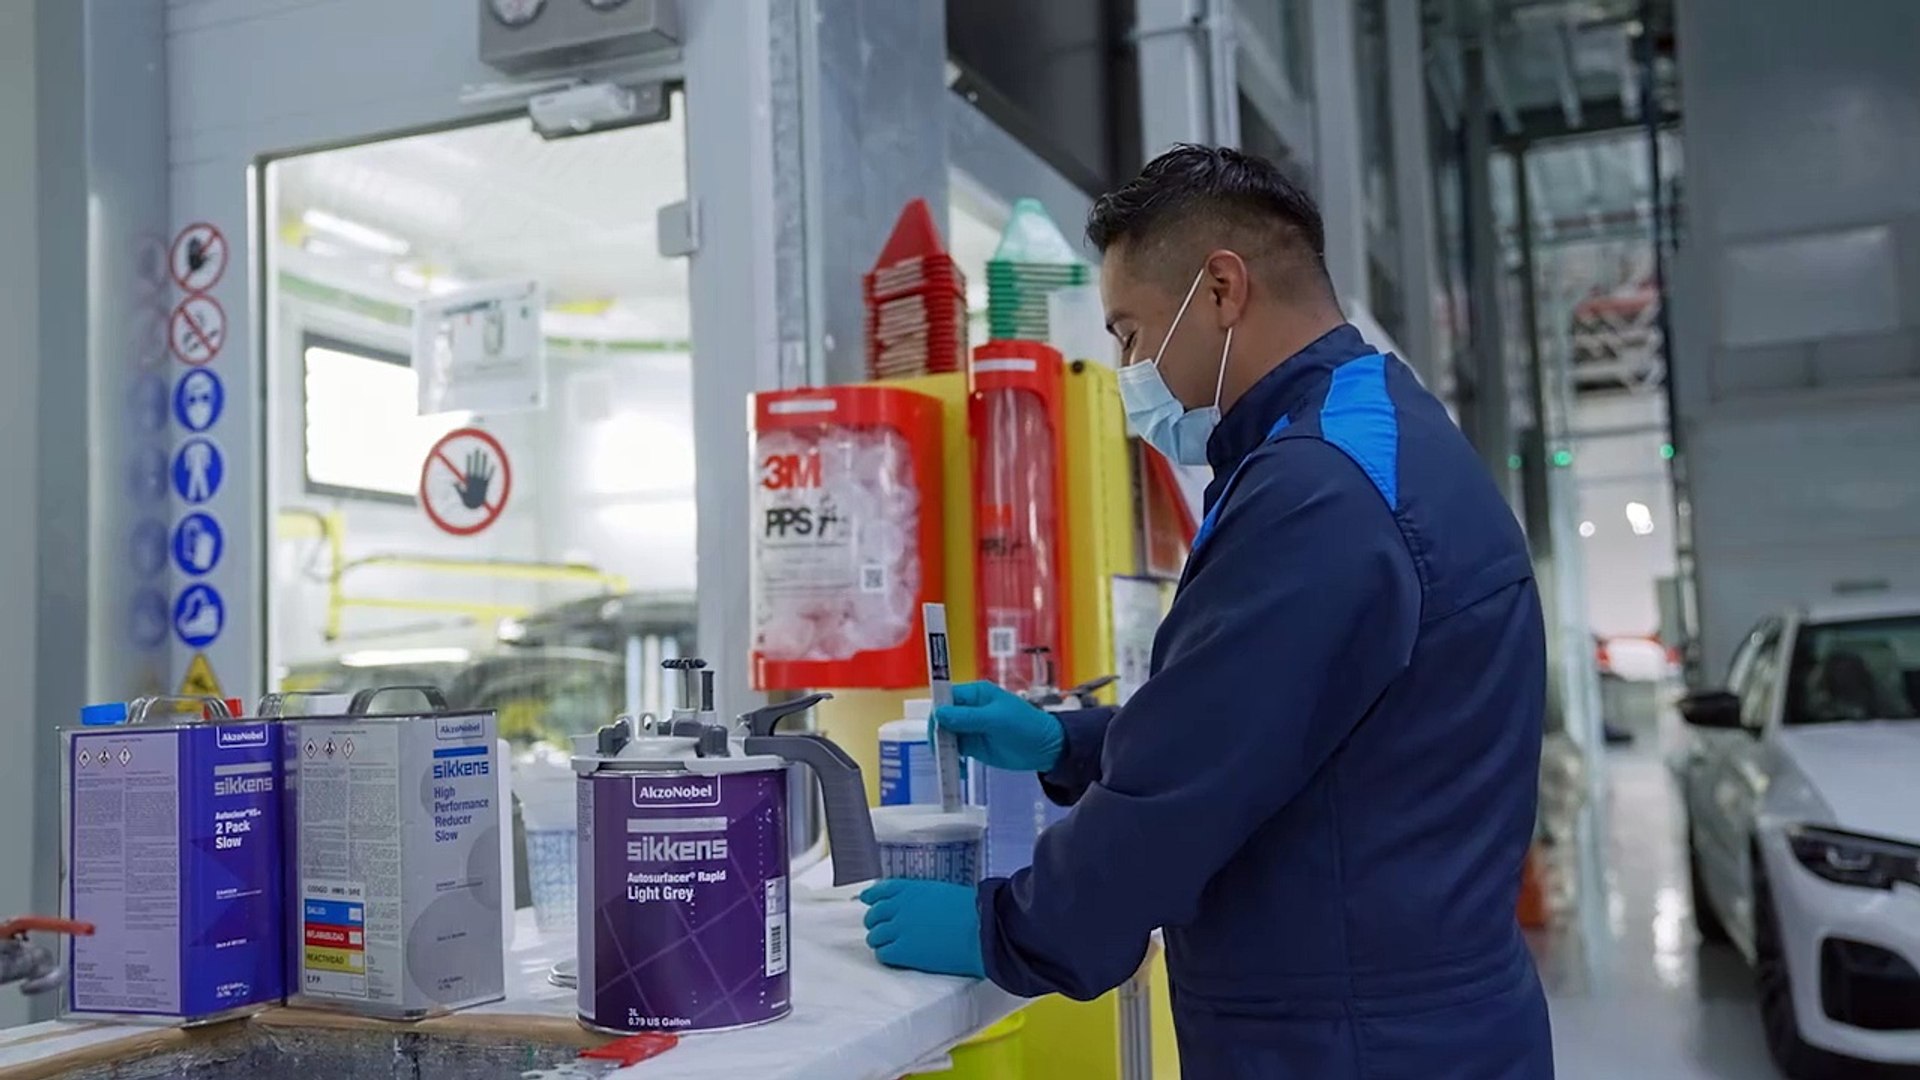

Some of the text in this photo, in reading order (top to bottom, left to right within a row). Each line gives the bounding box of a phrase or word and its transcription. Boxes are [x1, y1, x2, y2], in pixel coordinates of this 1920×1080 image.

[763, 454, 822, 490] 3M
[765, 507, 813, 537] PPS
[440, 723, 480, 734] AkzoNobel
[221, 731, 264, 742] AkzoNobel
[433, 760, 489, 780] sikkens
[214, 776, 273, 796] sikkens
[639, 784, 713, 799] AkzoNobel
[434, 787, 456, 801] High
[434, 798, 489, 813] Performance
[215, 820, 251, 835] 2 Pack
[434, 815, 472, 828] Reducer
[215, 837, 242, 849] Slow
[435, 830, 459, 842] Slow
[627, 835, 728, 861] sikkens
[697, 870, 726, 883] Rapid
[628, 885, 694, 903] Light Grey
[647, 1017, 661, 1027] US
[662, 1016, 692, 1027] Gallon
